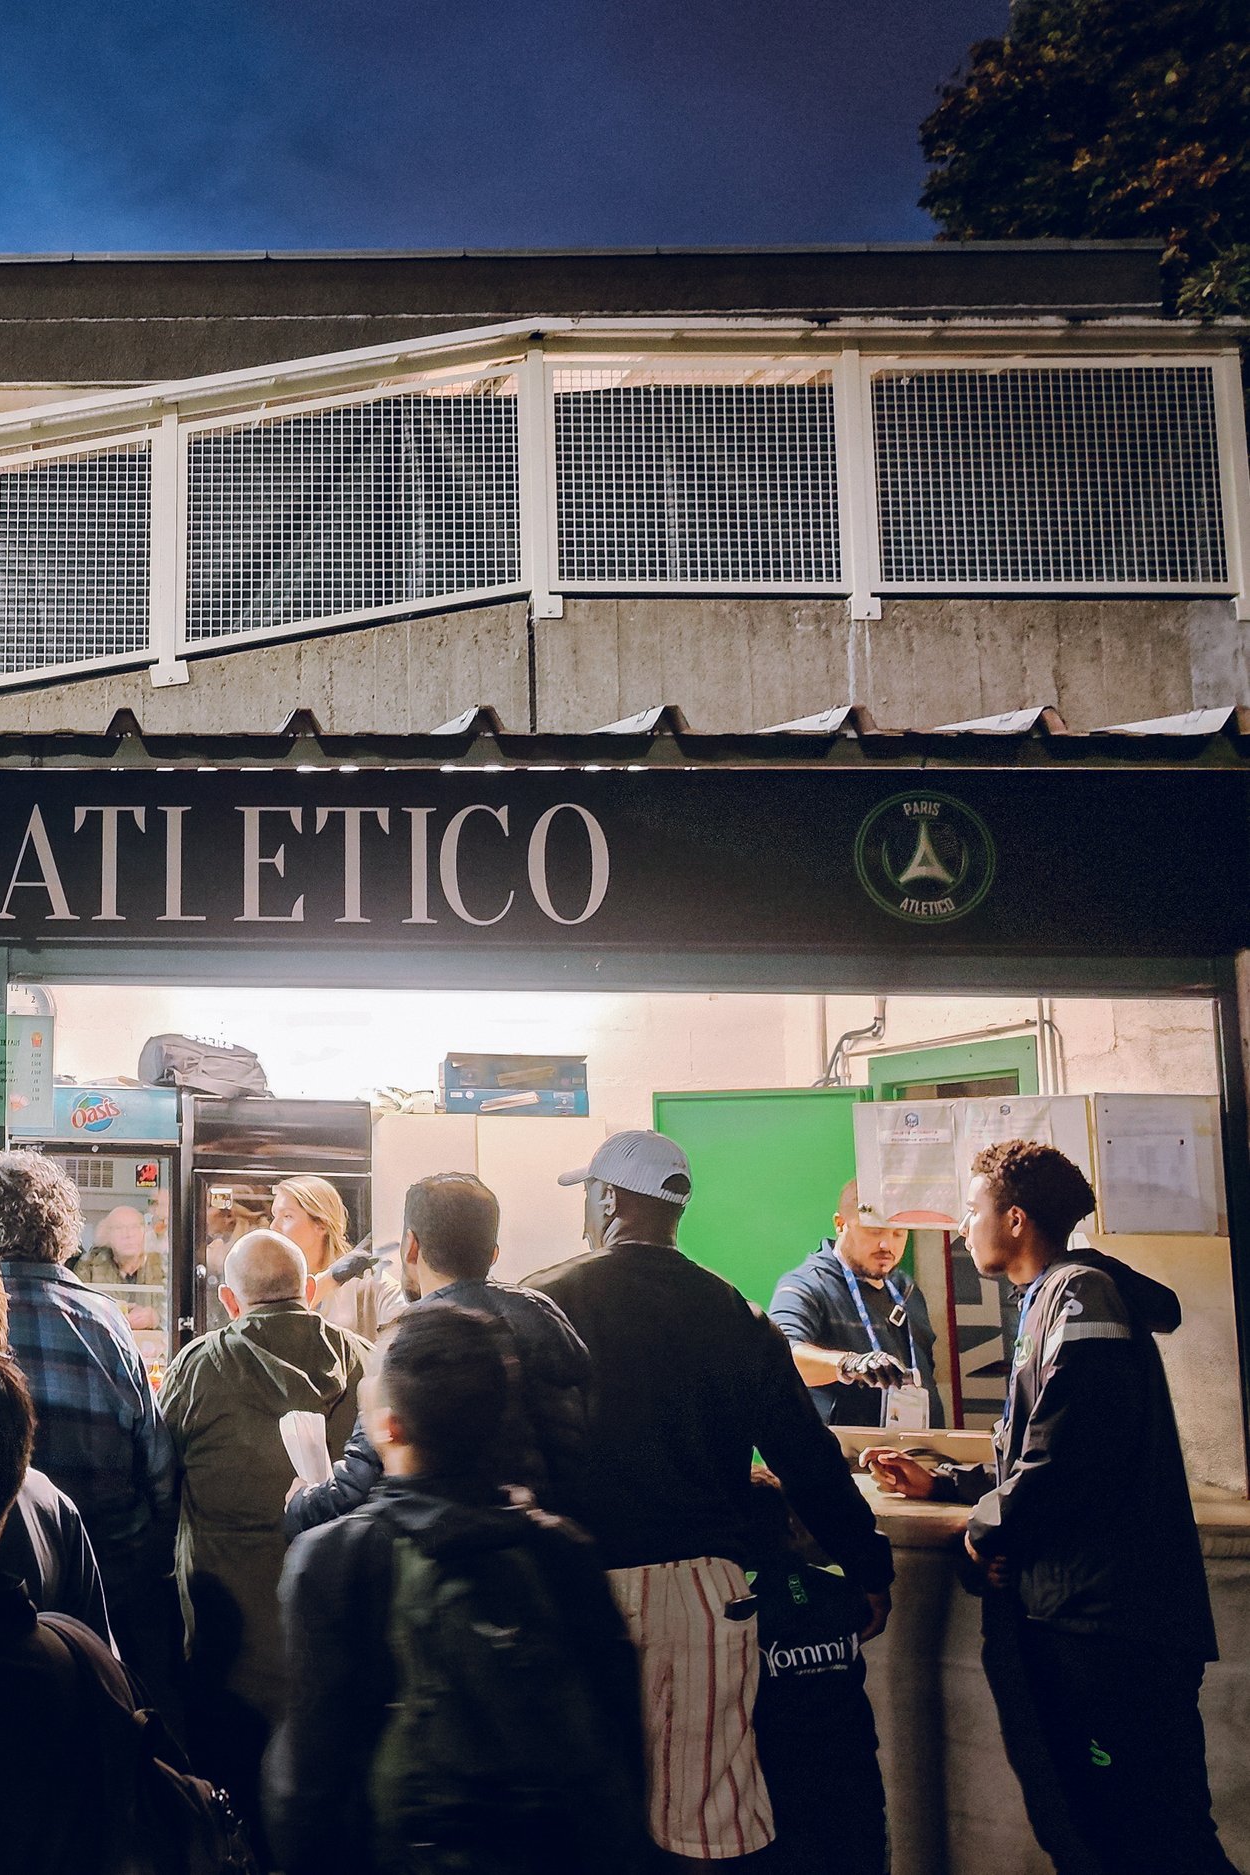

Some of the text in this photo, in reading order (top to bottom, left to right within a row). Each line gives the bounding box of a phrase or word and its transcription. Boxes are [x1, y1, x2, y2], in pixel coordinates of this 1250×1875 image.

[903, 801, 940, 816] PARIS
[900, 897, 955, 916] ATLETICO
[72, 1098, 121, 1128] Oasis
[759, 1636, 845, 1677] Yommi
